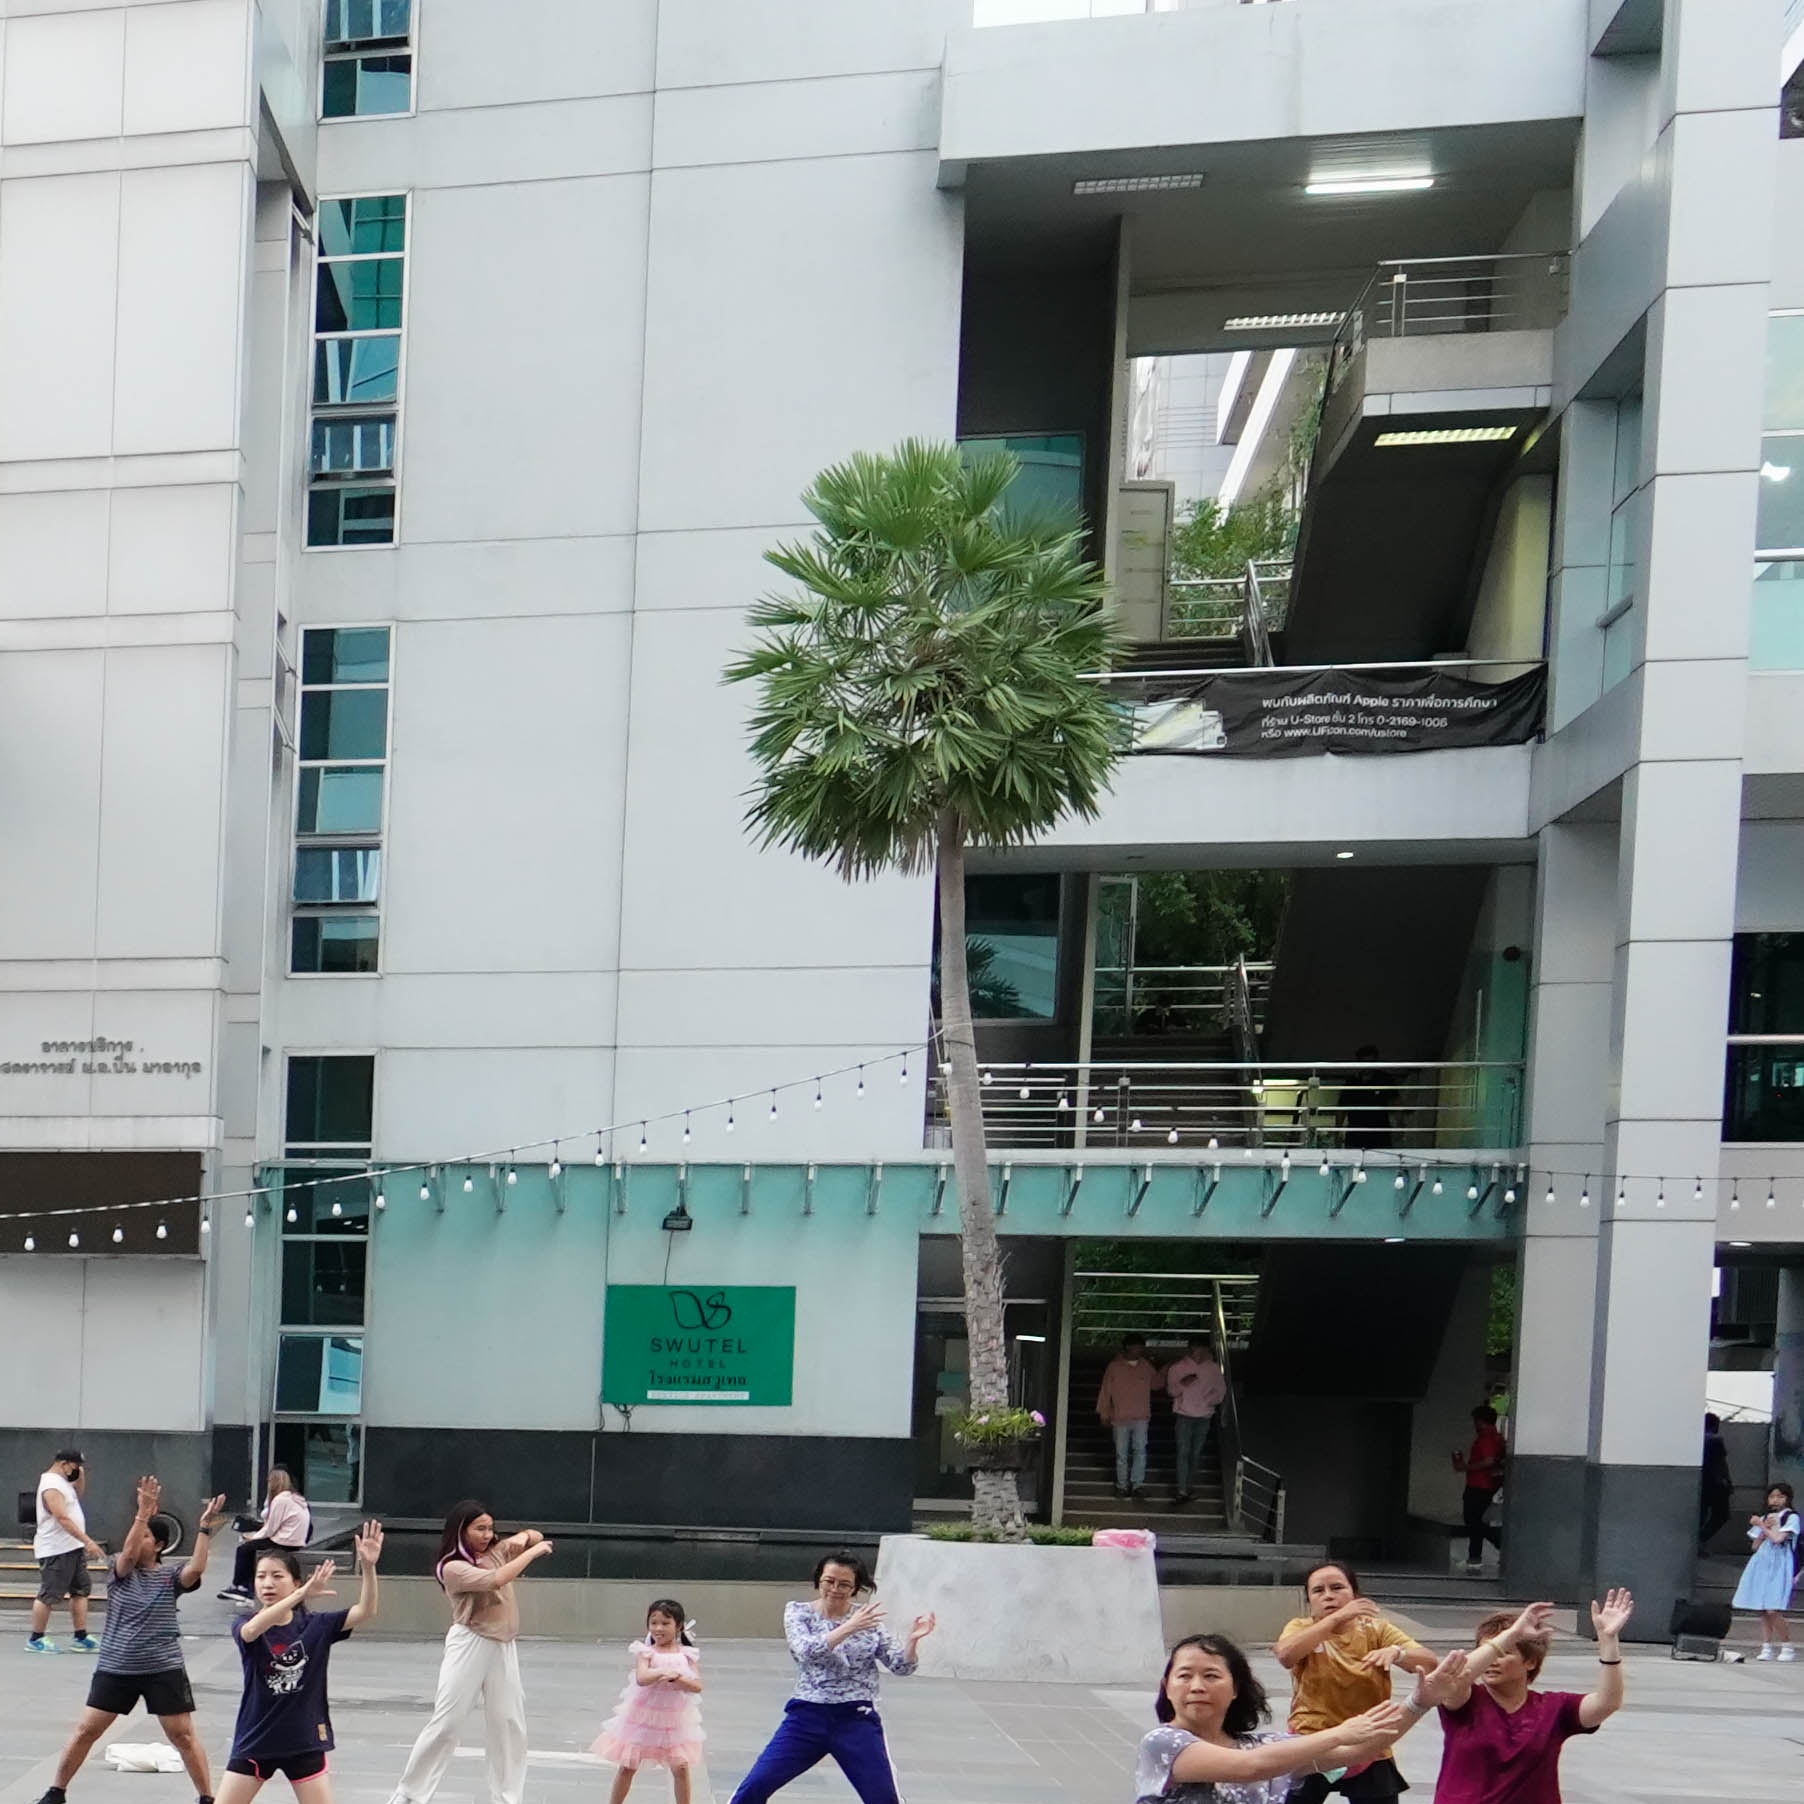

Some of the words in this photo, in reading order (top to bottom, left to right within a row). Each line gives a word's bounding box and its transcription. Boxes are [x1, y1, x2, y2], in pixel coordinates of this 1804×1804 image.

[1353, 694, 1390, 707] Apple
[1348, 714, 1355, 724] 2
[649, 1337, 748, 1353] SWUTEL
[670, 1359, 727, 1369] HOTEL
